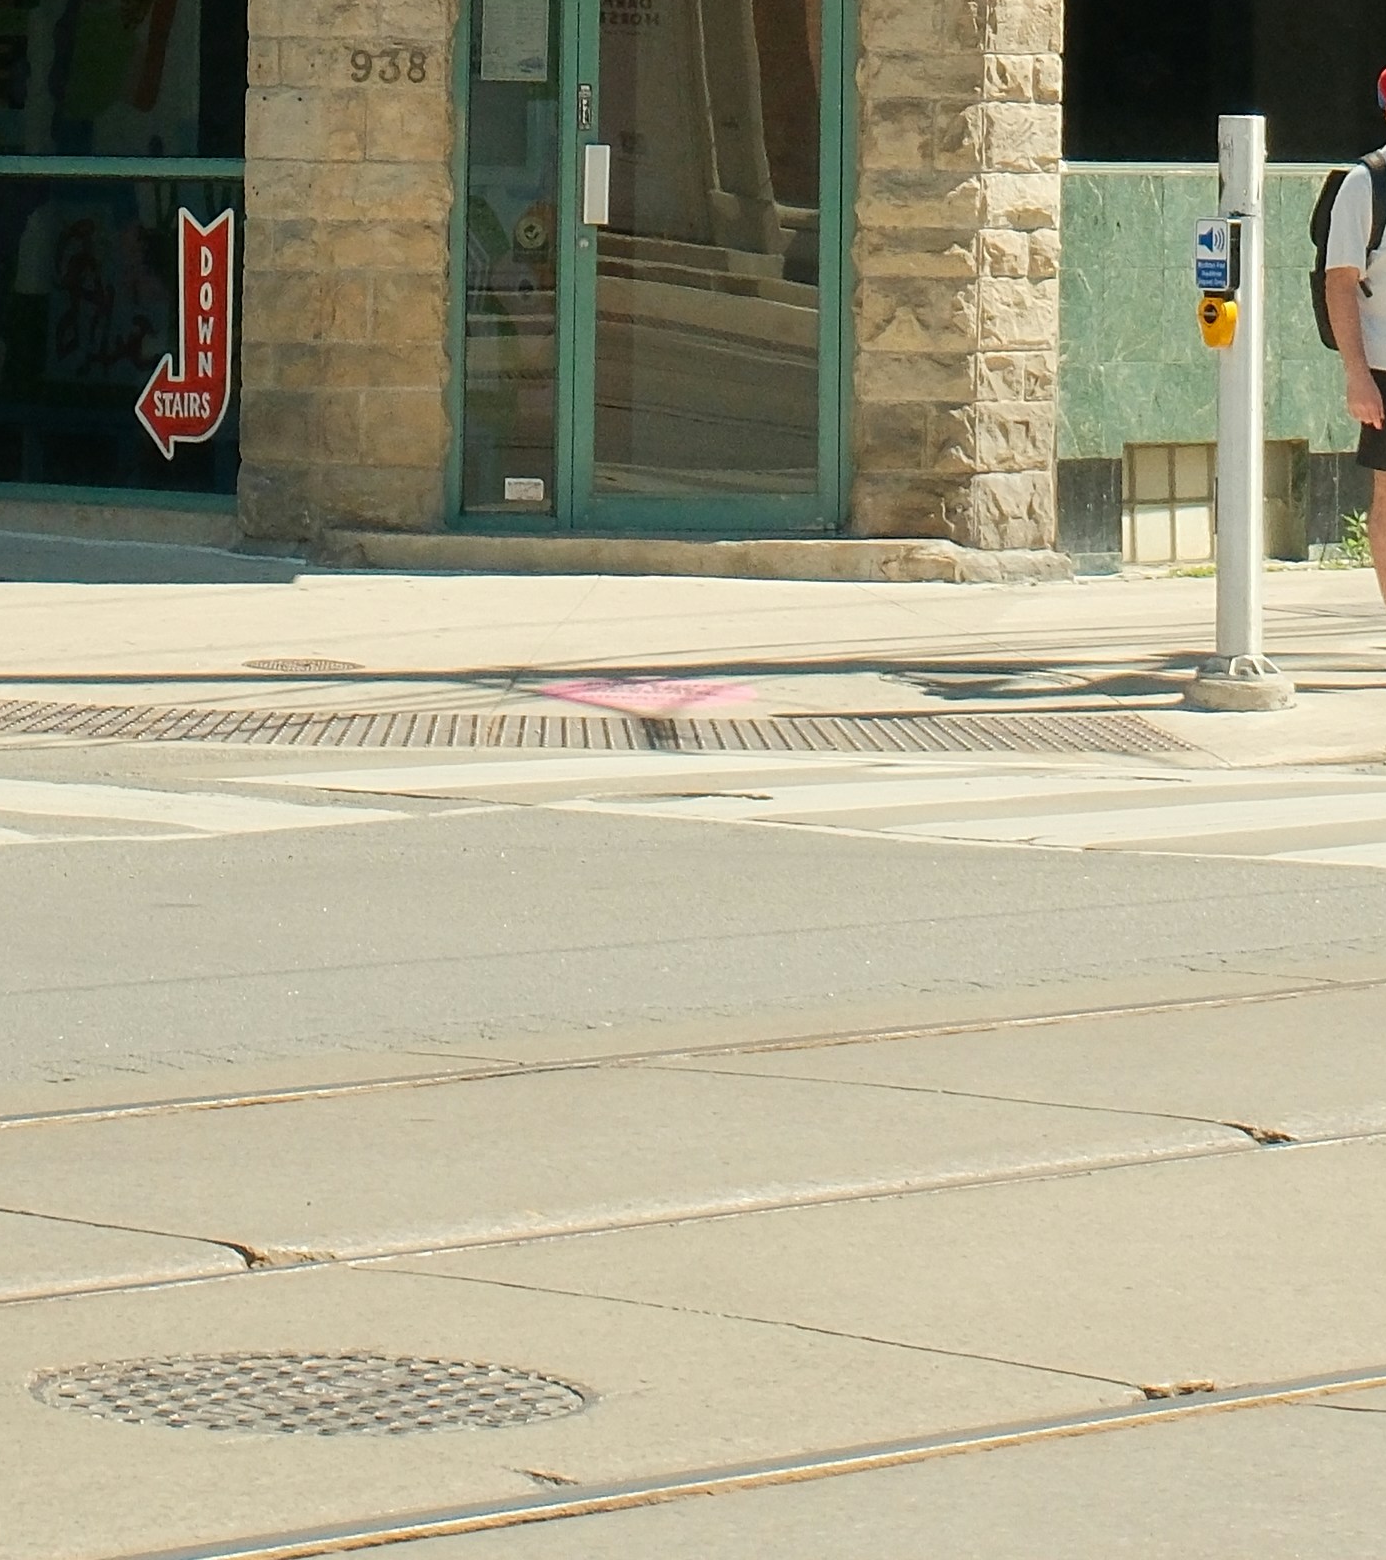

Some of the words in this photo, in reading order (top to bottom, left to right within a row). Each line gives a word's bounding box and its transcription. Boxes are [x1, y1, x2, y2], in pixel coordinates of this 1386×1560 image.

[350, 49, 427, 84] 938
[198, 246, 214, 378] DOWN
[153, 389, 211, 419] STAIRS
